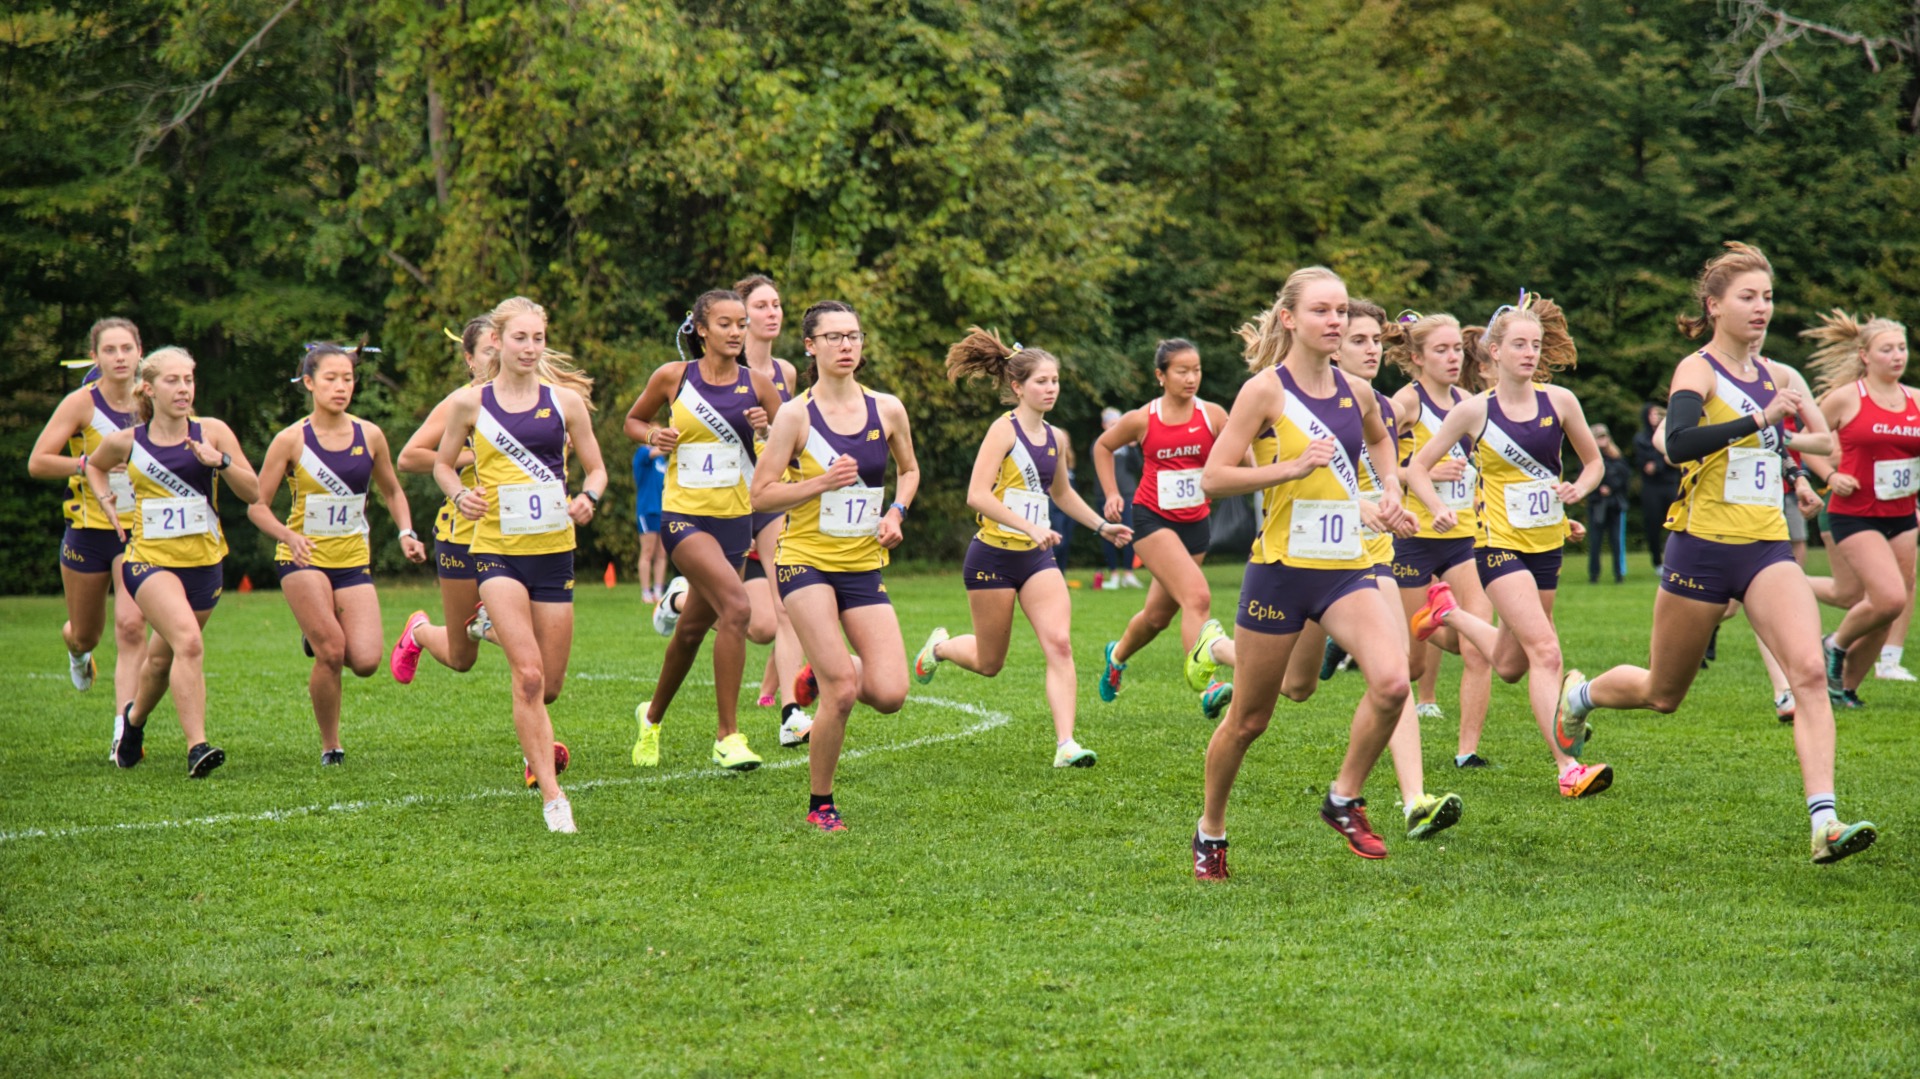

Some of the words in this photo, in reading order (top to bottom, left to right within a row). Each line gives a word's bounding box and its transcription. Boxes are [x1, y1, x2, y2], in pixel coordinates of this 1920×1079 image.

[695, 402, 743, 456] WILLIA
[1872, 422, 1920, 438] CLARK
[494, 431, 553, 483] WILLIAM
[1156, 444, 1202, 460] CLARK
[702, 453, 714, 476] 4
[1755, 461, 1766, 490] 5
[146, 462, 196, 498] WILLIA
[1176, 477, 1195, 498] 35
[1892, 468, 1911, 489] 38
[529, 494, 543, 520] 9
[845, 498, 867, 524] 17
[1024, 502, 1039, 525] 11
[1528, 490, 1550, 516] 20
[163, 507, 186, 530] 21
[327, 505, 347, 526] 14
[1319, 514, 1343, 543] 10
[440, 553, 465, 569] Ephs
[1392, 562, 1420, 579] Ephs
[1487, 551, 1518, 568] Ephs
[778, 565, 807, 582] Ephs
[1248, 600, 1286, 620] Ephs
